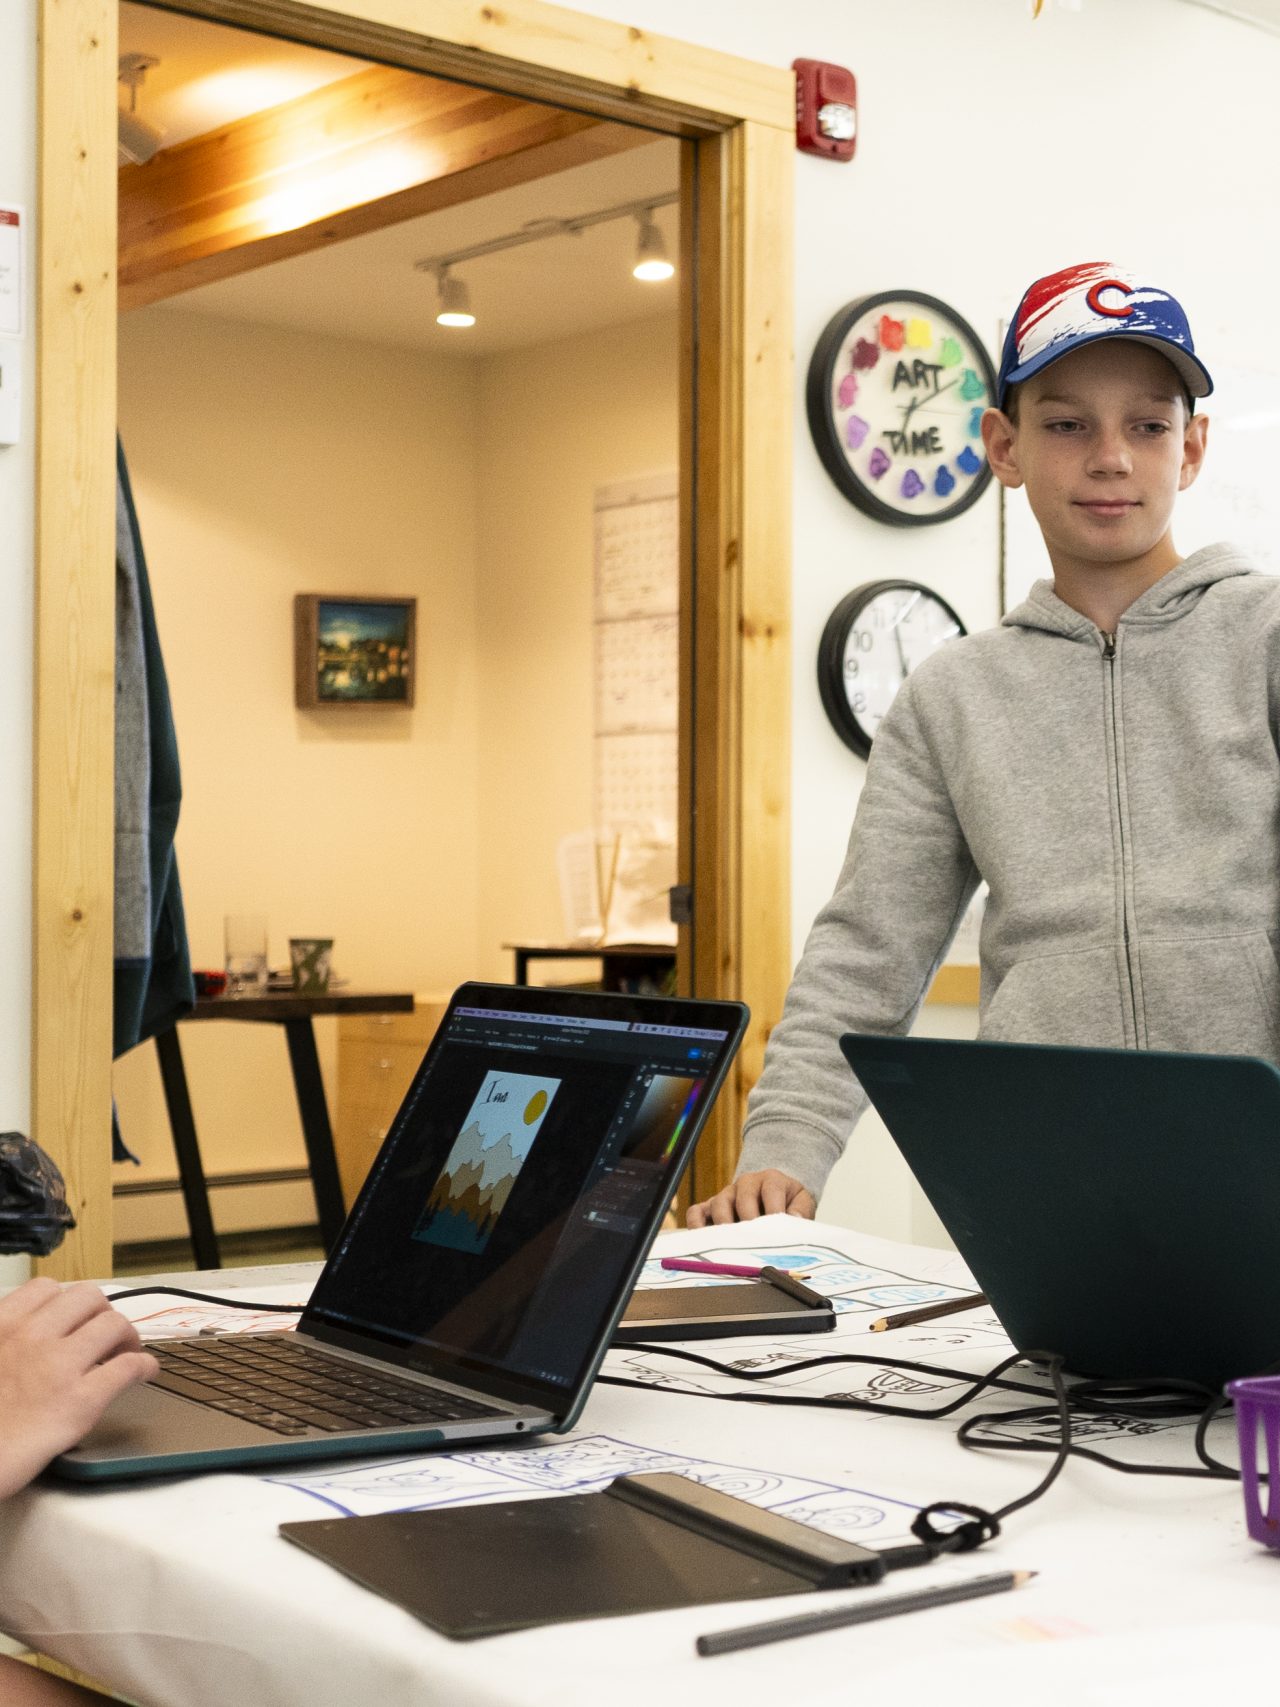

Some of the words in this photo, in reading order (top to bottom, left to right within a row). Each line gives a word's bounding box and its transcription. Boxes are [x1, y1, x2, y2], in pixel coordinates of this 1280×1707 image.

[1086, 280, 1134, 317] C
[893, 359, 944, 393] ART
[882, 426, 944, 455] TIME
[852, 629, 873, 653] 10
[846, 658, 859, 680] 9
